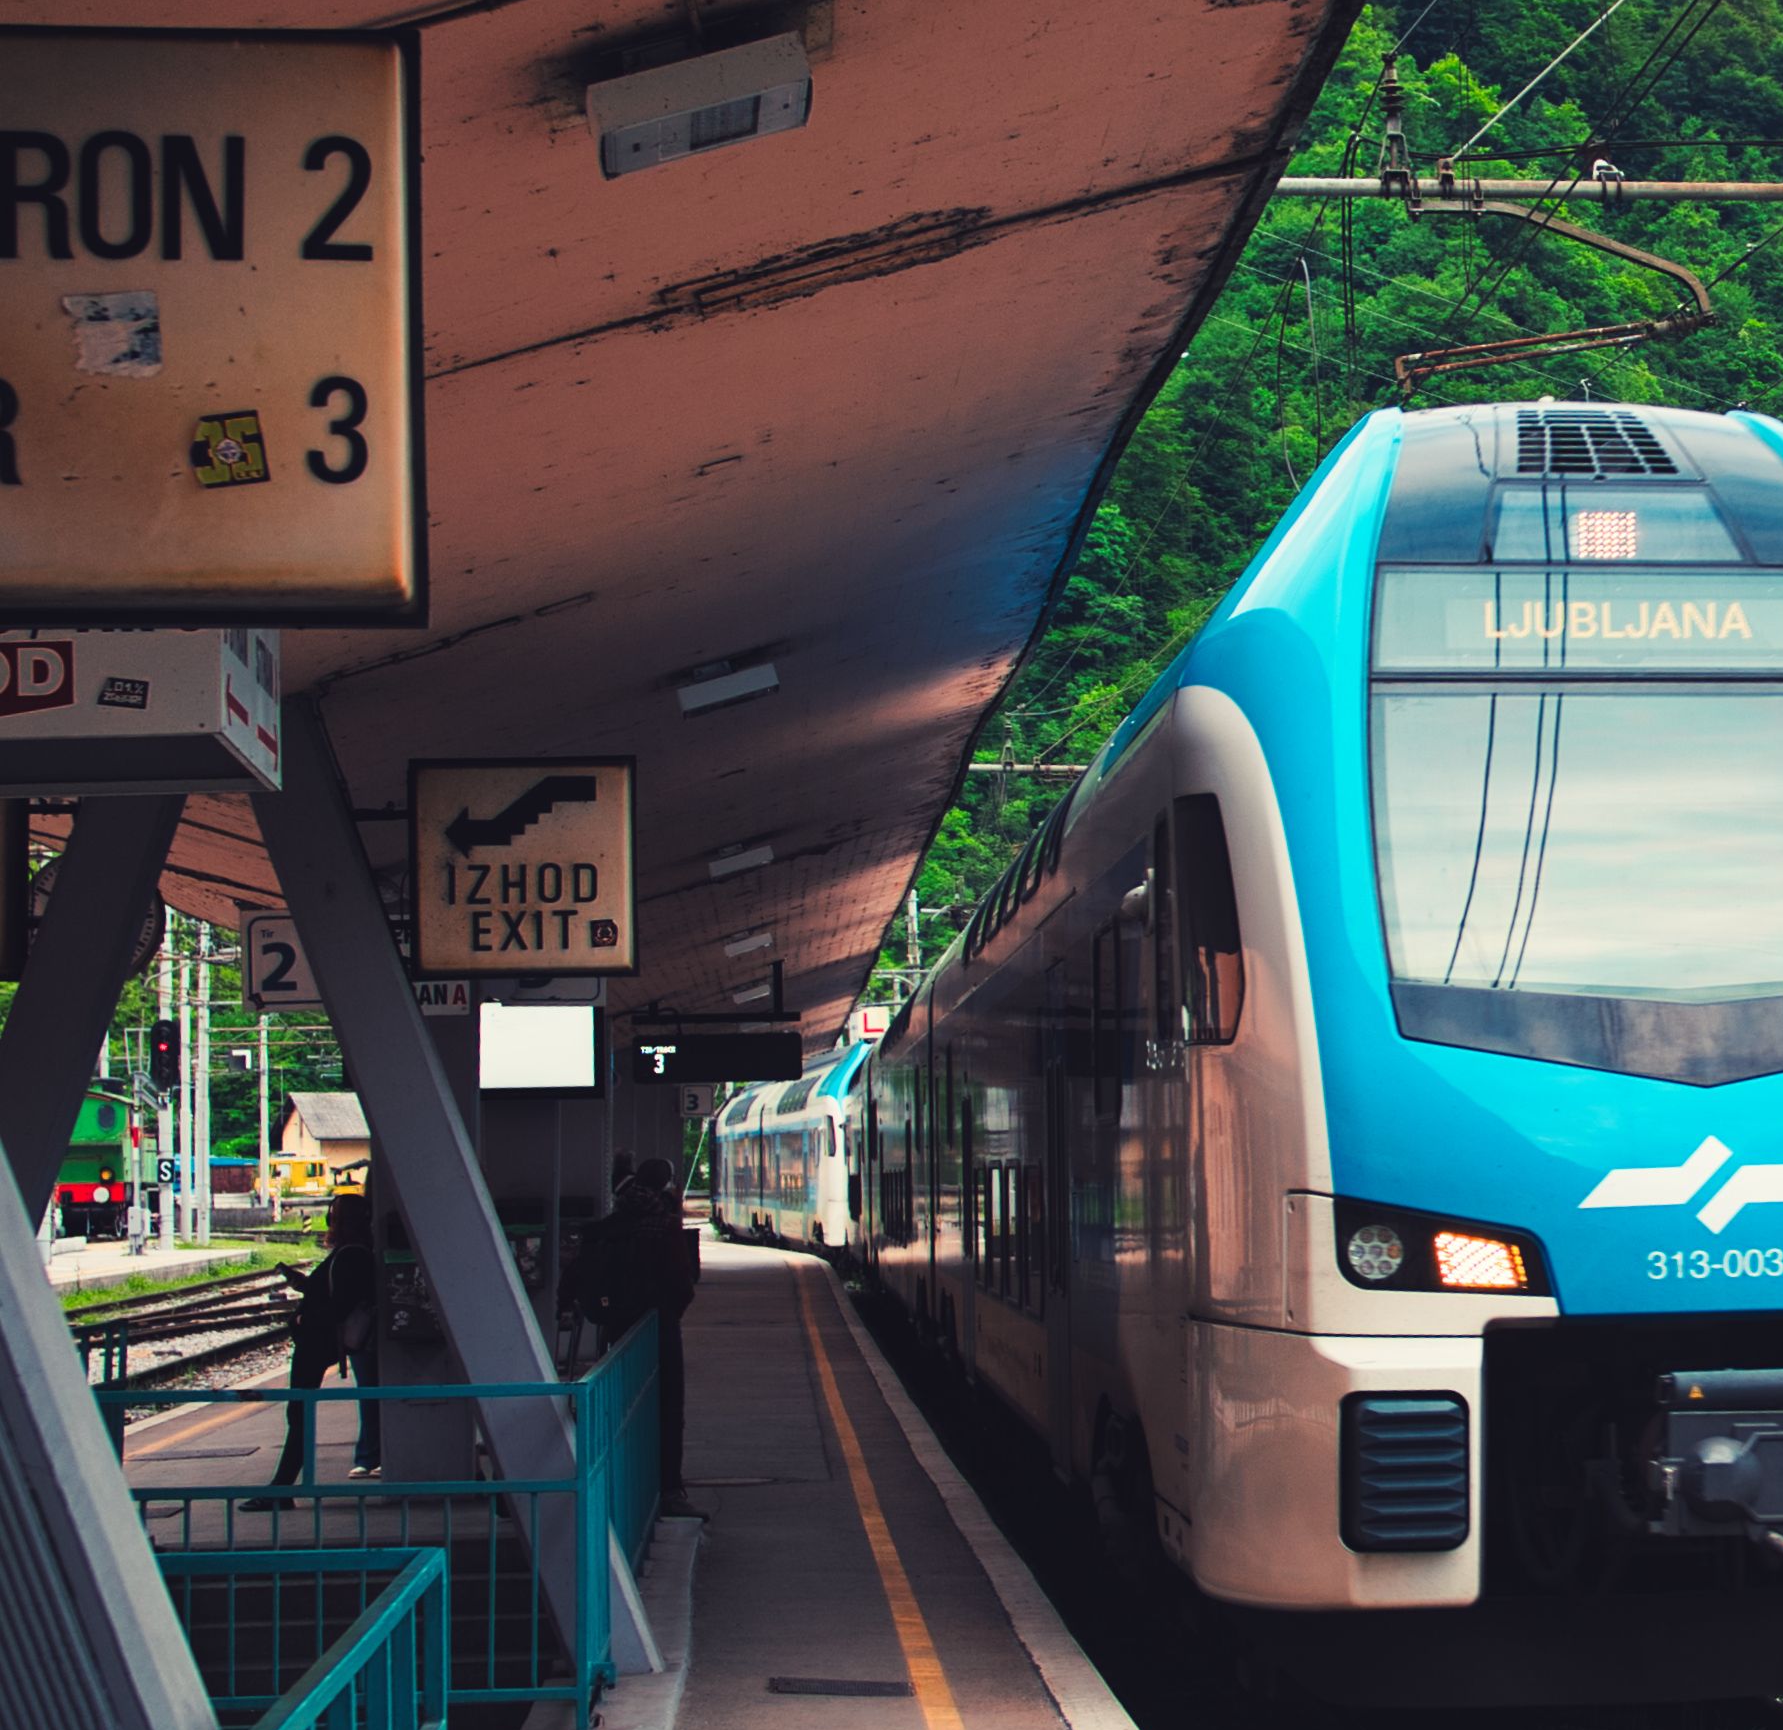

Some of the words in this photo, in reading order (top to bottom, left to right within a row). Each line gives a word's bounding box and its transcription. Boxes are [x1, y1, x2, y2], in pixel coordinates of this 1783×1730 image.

[0, 130, 245, 262] RON
[302, 136, 374, 262] 2
[306, 375, 369, 485] 3
[1483, 600, 1754, 640] LJUBLJANA
[446, 861, 599, 906] IZHOD
[261, 929, 274, 938] Tir
[472, 909, 579, 952] EXIT
[262, 942, 298, 992] 2
[653, 1054, 665, 1074] 3
[686, 1093, 699, 1111] 3
[159, 1161, 172, 1180] S
